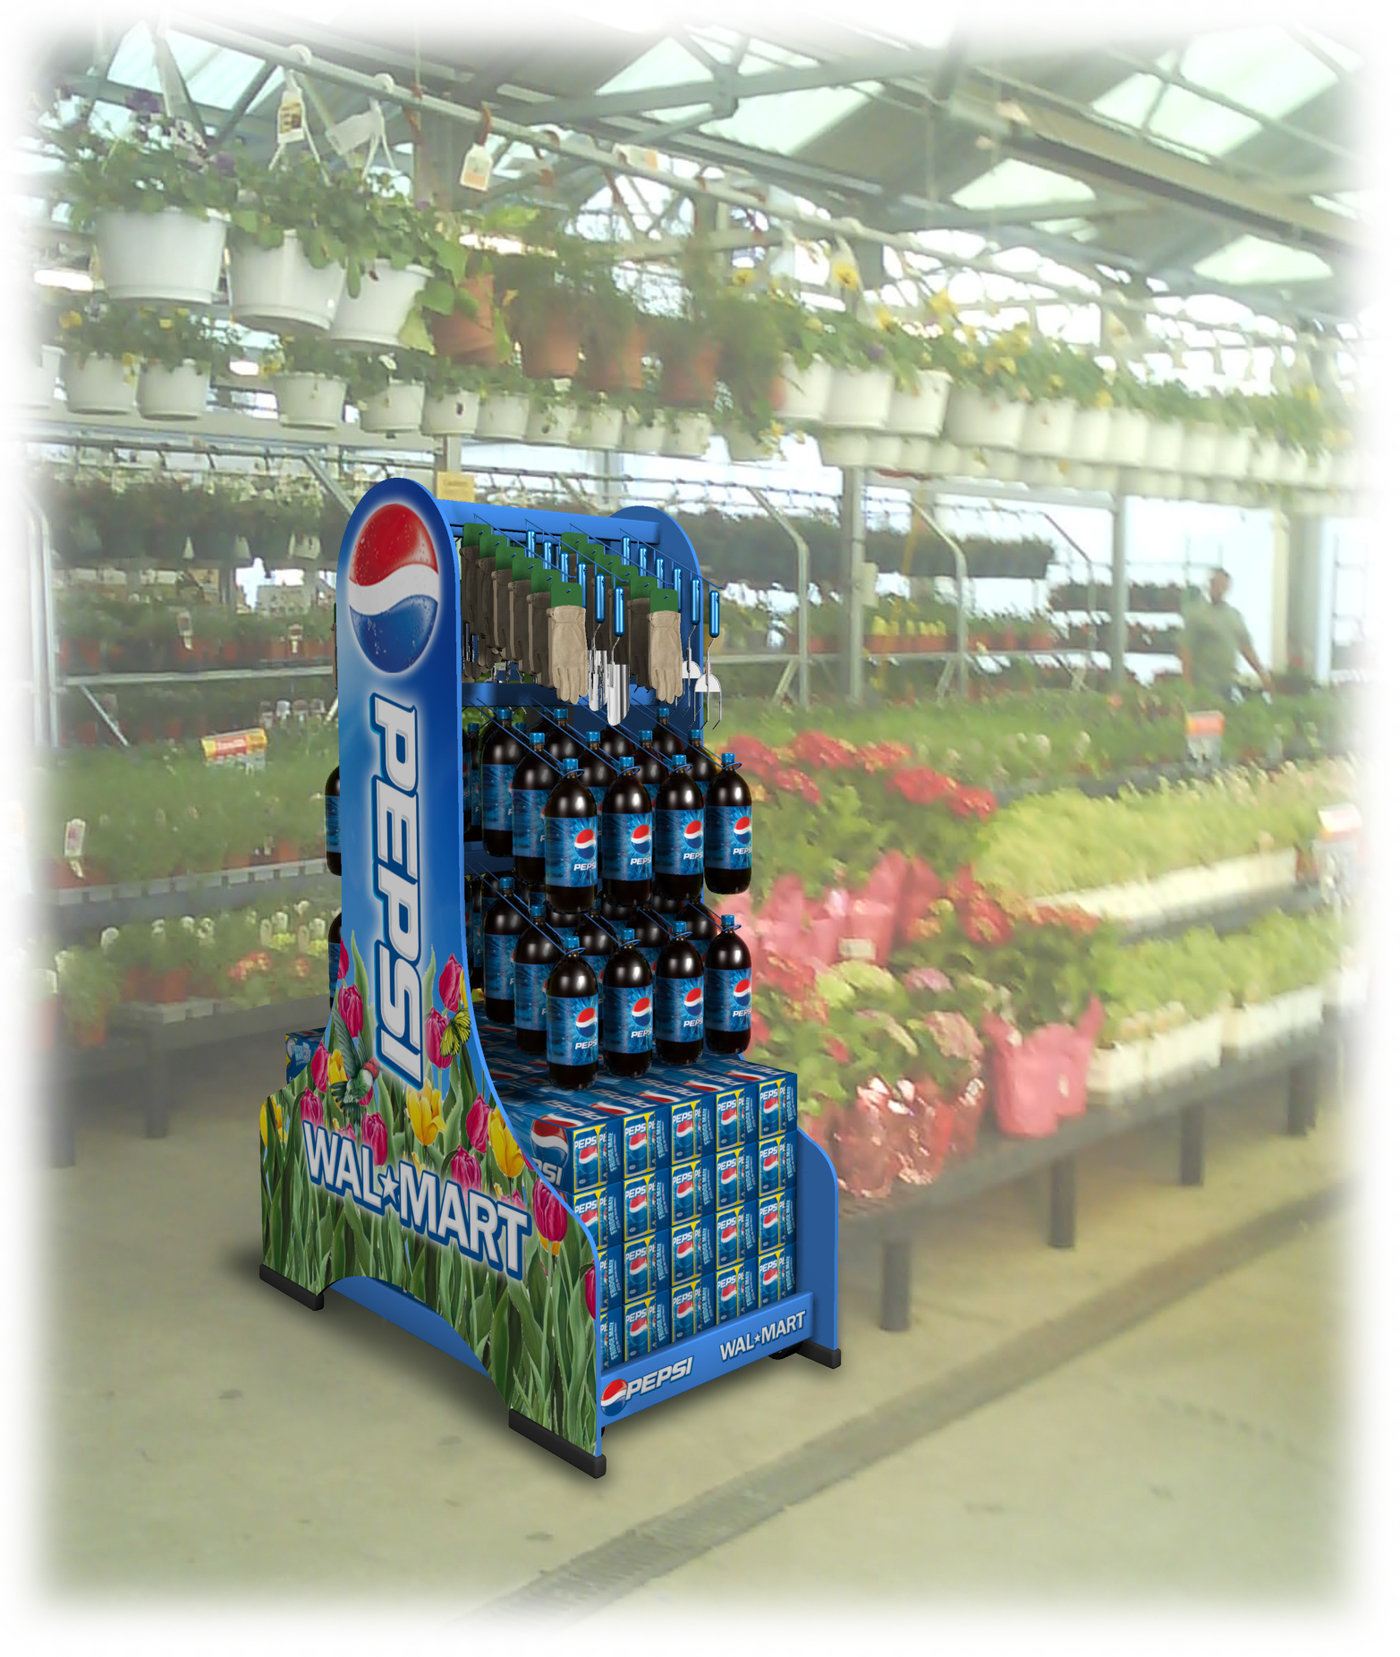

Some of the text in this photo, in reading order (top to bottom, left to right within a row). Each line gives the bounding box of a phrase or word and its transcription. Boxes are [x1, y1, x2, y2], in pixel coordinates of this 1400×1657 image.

[683, 851, 703, 861] PEPS
[733, 846, 752, 856] PEPS
[574, 862, 596, 872] PEPS
[630, 856, 651, 866] PEPS
[370, 692, 424, 1090] PEPSI
[733, 1009, 752, 1019] PEPS
[683, 1016, 703, 1028] PEPS
[631, 1029, 652, 1040] PEPS
[575, 1040, 597, 1051] PEPS
[679, 1067, 747, 1085] PEPSI
[636, 1077, 703, 1096] PEPSI
[590, 1088, 657, 1109] PEPSI
[760, 1089, 778, 1100] PEPS
[540, 1099, 610, 1121] PEPSI
[718, 1099, 736, 1112] PEPS
[672, 1110, 692, 1123] PEPS
[624, 1122, 646, 1136] PEPS
[574, 1135, 598, 1150] PEPS
[760, 1146, 778, 1158] PEPS
[718, 1158, 736, 1171] PEPS
[672, 1171, 692, 1184] PEPS
[624, 1184, 646, 1198] PEPS
[574, 1200, 598, 1214] PEPS
[760, 1202, 778, 1216] PEPS
[718, 1217, 736, 1230] PEPS
[672, 1232, 692, 1245] PEPS
[625, 1247, 647, 1260] PEPS
[760, 1260, 778, 1272] PEPS
[718, 1275, 736, 1288] PEPS
[672, 1291, 692, 1305] PEPS
[625, 1308, 647, 1322] PEPS
[625, 1355, 695, 1401] PEPSI
